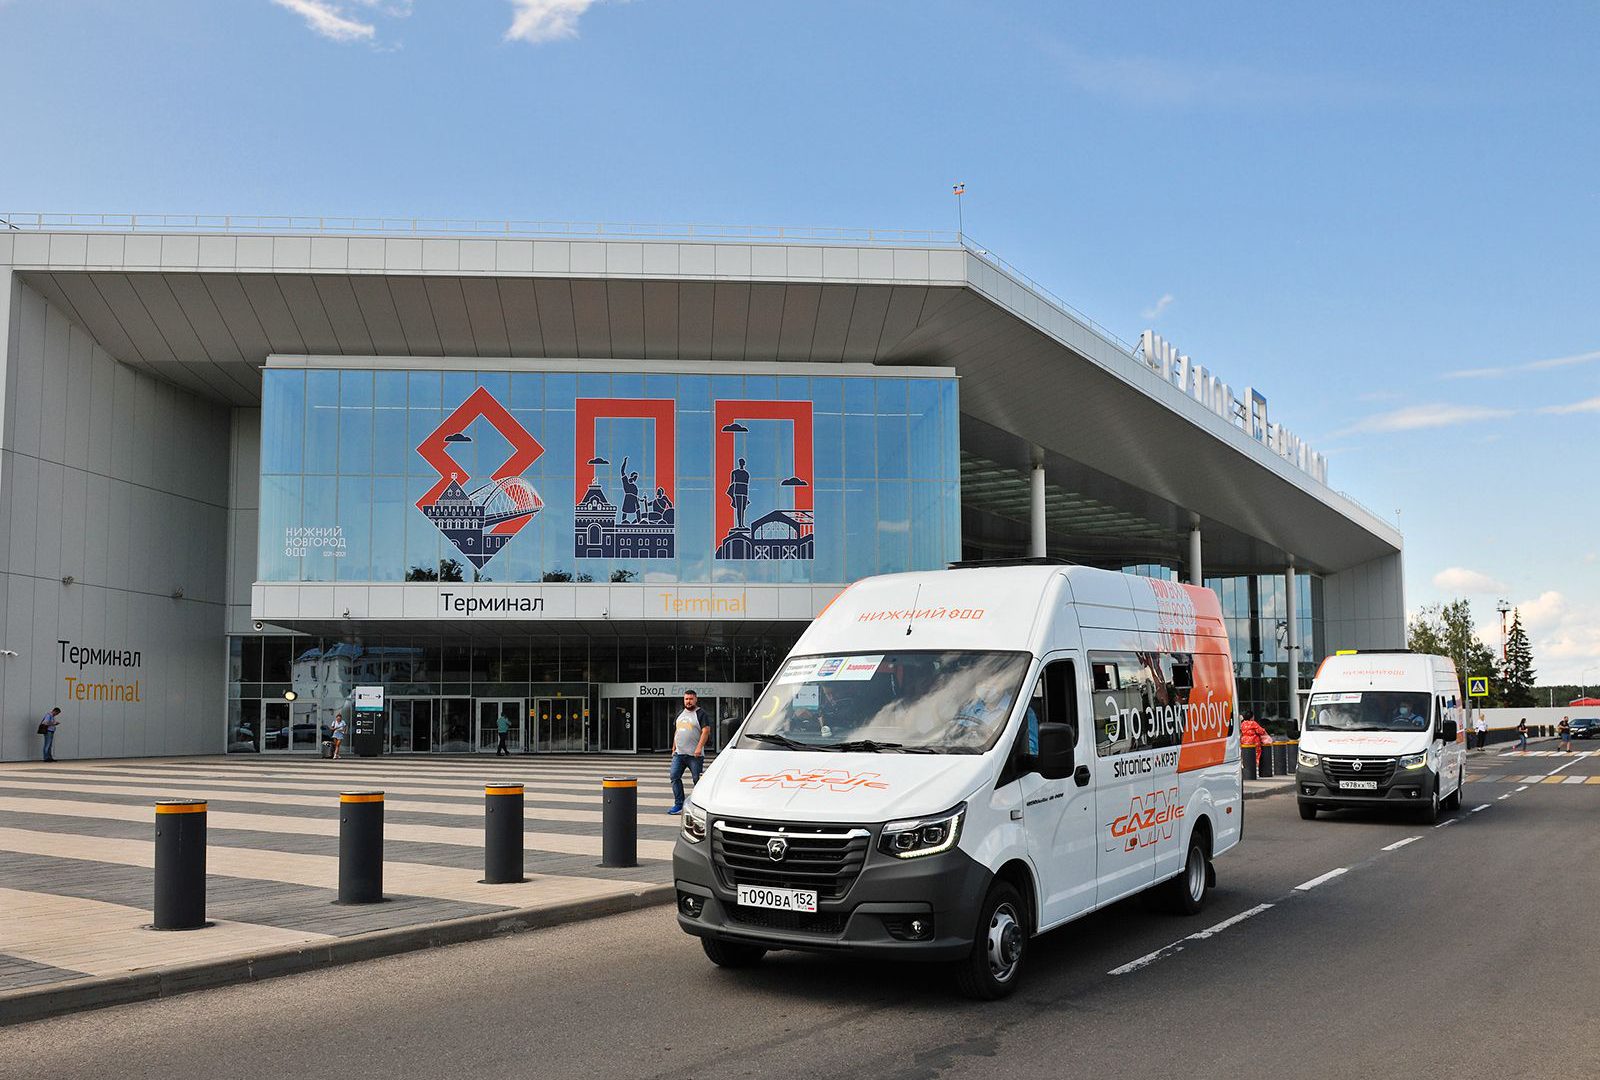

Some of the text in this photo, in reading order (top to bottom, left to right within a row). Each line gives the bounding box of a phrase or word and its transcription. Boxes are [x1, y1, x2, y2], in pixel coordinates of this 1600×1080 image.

[285, 525, 342, 537] НИЖНИЙ
[285, 537, 346, 549] НОВГОРОД
[441, 592, 544, 616] Терминал
[659, 591, 747, 613] Terminal
[58, 640, 141, 670] Терминал
[65, 677, 141, 702] Terminal
[640, 685, 675, 696] Вход
[671, 685, 714, 696] Enance
[1105, 689, 1233, 743] Это электробус.
[1114, 756, 1152, 778] sitronics
[1161, 751, 1177, 767] КРЭТ
[1111, 804, 1184, 837] GAZelle
[741, 889, 813, 907] Т090ВА 152
